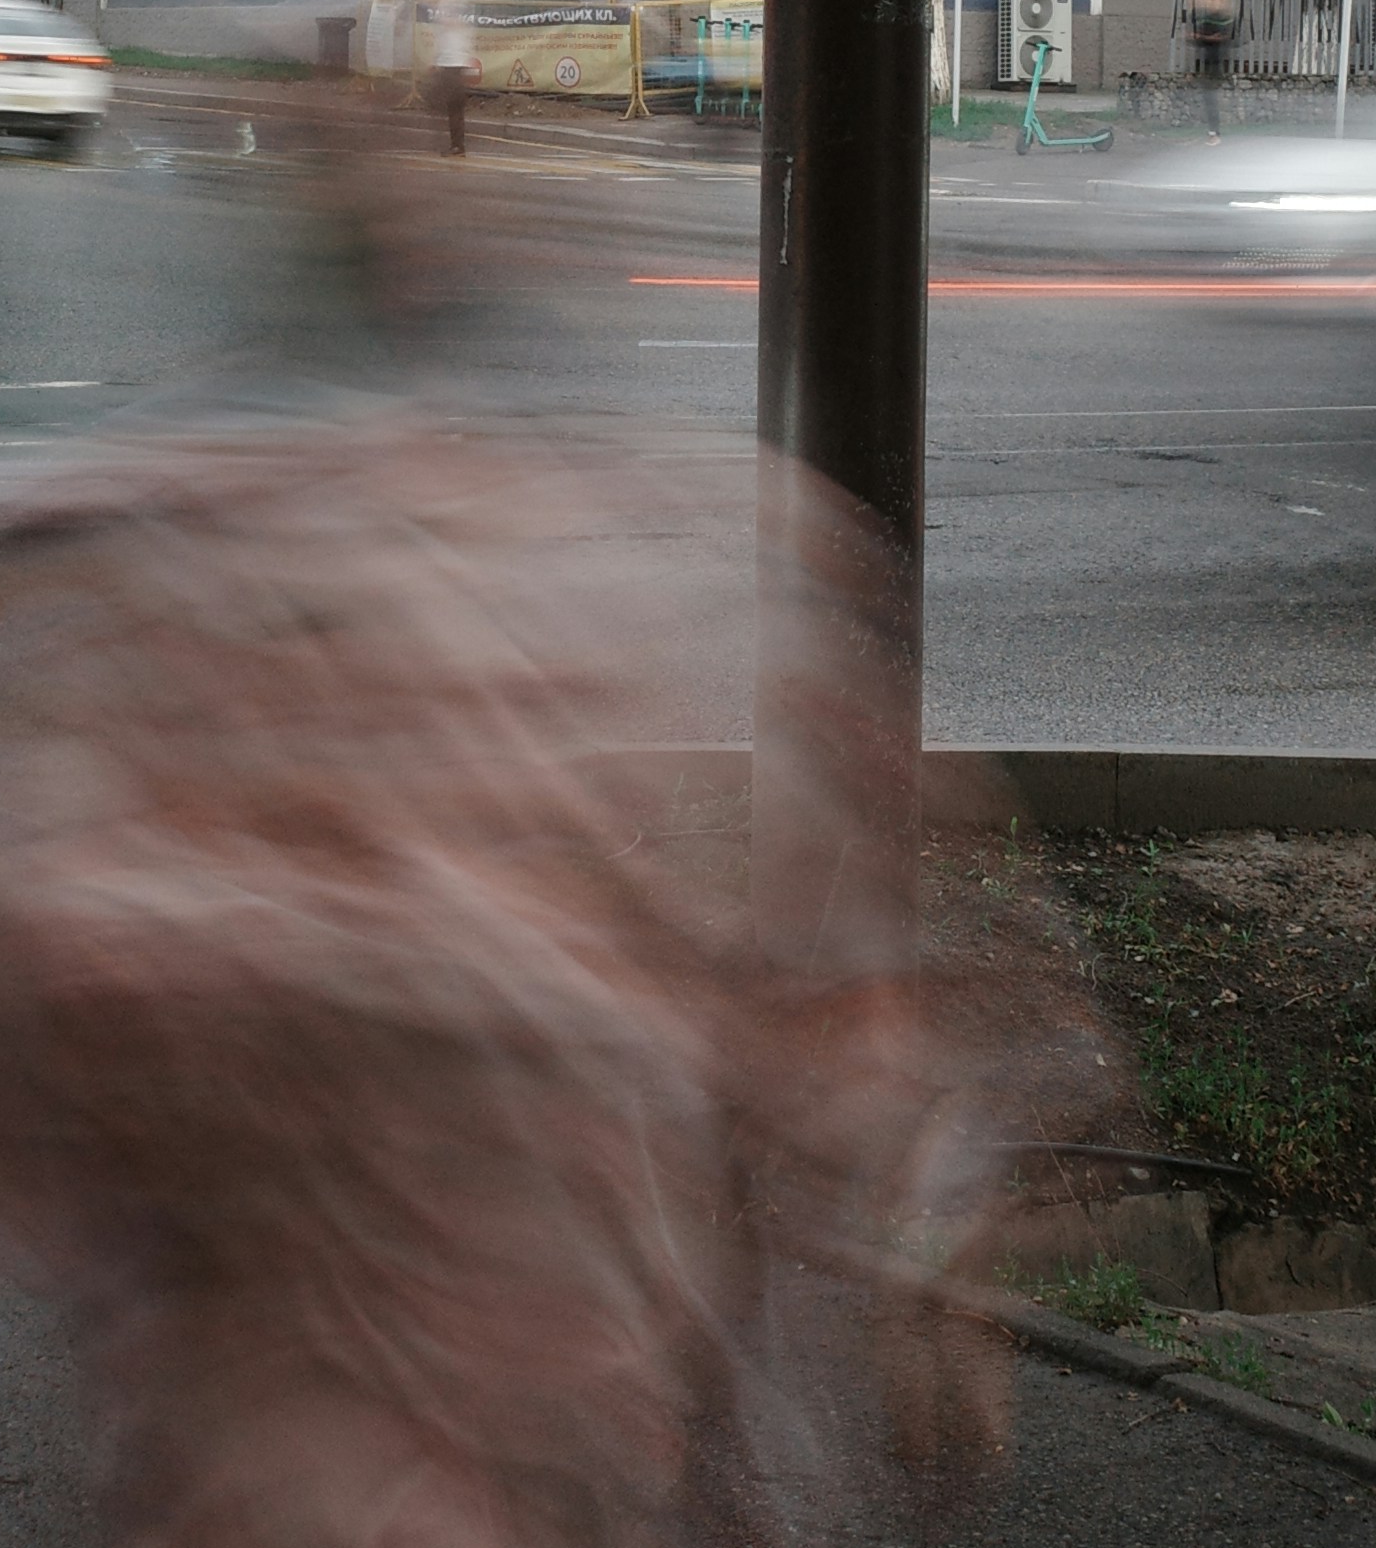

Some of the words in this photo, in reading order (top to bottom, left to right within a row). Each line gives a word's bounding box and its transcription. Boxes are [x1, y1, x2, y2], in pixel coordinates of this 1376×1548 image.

[477, 8, 592, 27] СУЩЕСТВУЮЩИХ
[595, 9, 617, 22] КЛ.
[560, 66, 575, 79] 20
